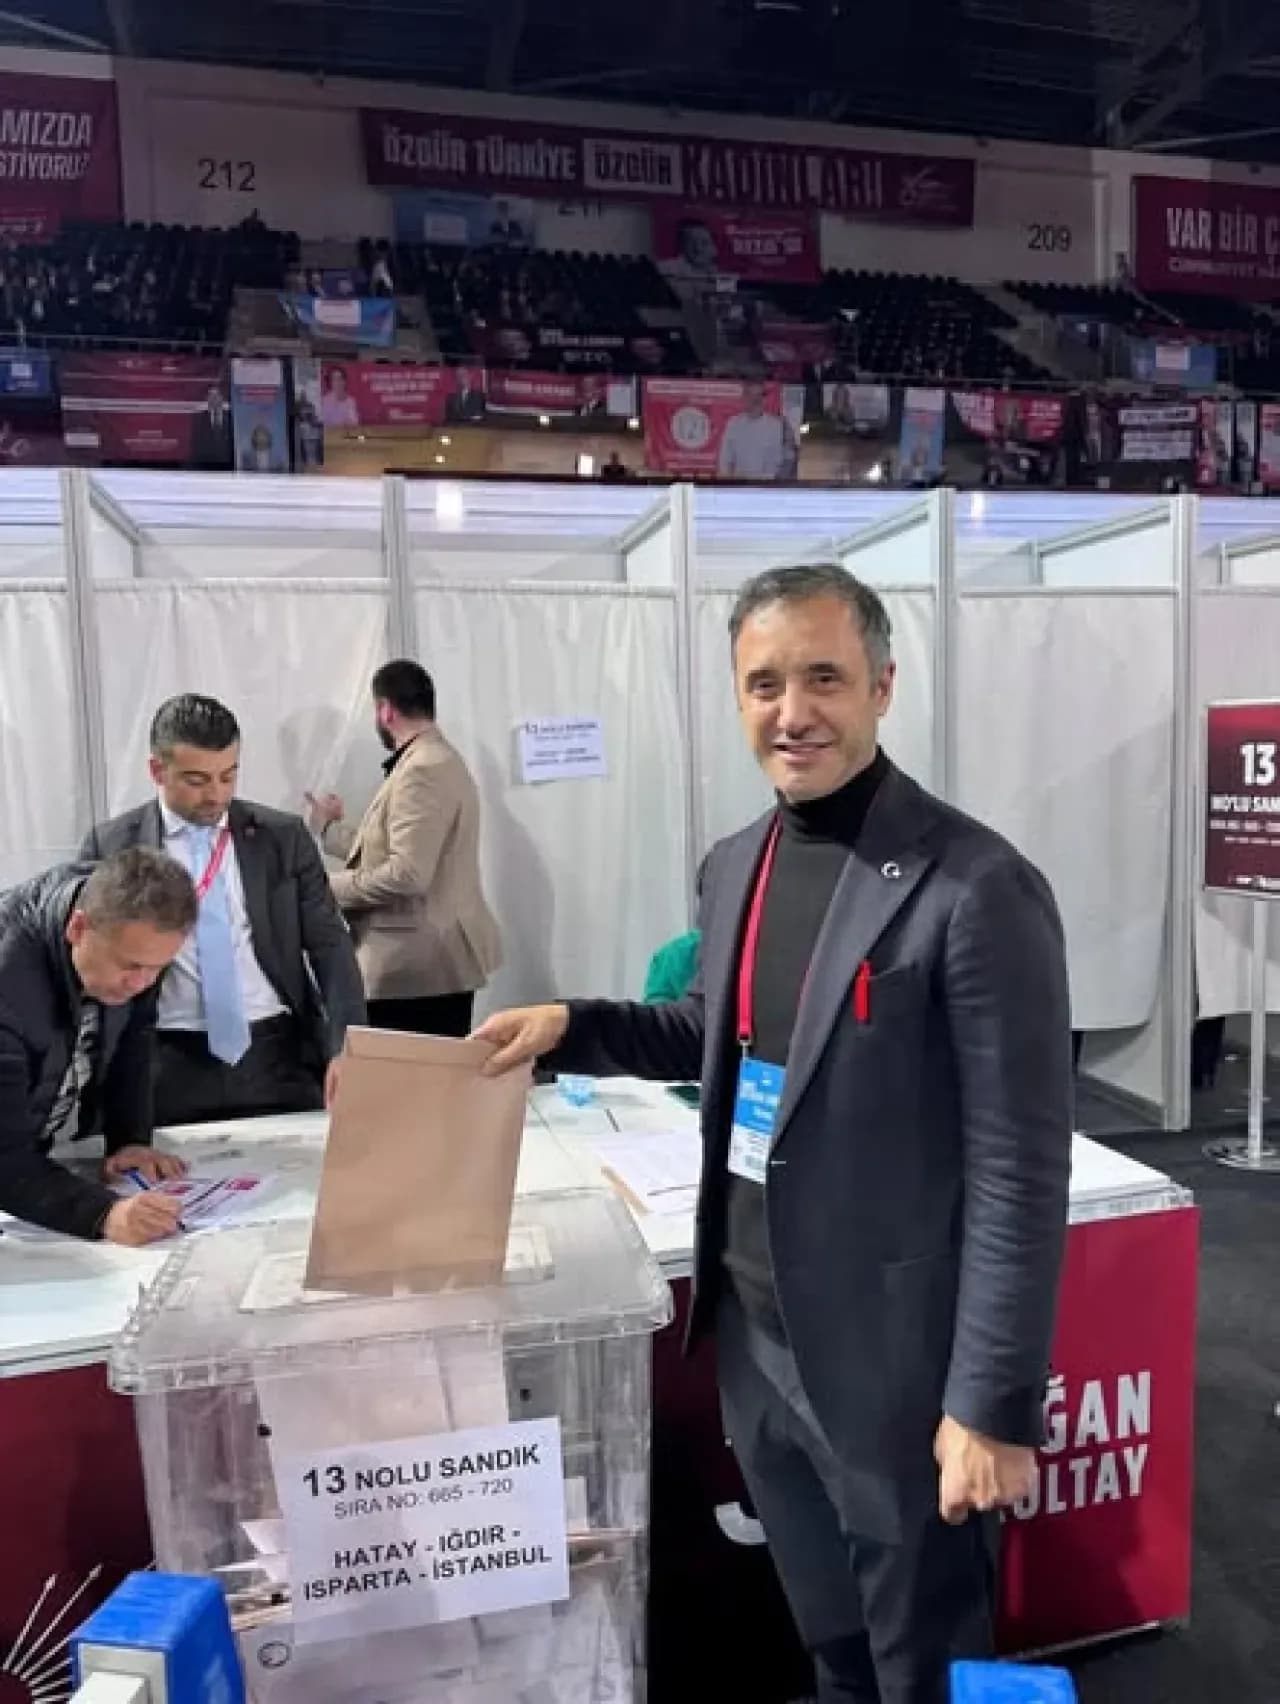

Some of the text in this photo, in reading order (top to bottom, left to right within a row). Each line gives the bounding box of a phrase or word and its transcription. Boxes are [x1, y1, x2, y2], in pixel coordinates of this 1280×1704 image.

[0, 110, 92, 147] MIZDA
[198, 158, 256, 191] 212
[1028, 224, 1072, 253] 209
[1166, 207, 1212, 249] VAR
[1219, 204, 1258, 255] BİR
[1240, 742, 1277, 786] 13
[303, 1443, 541, 1497] 13 NOLU SANDIK
[334, 1495, 383, 1519] SIRA
[480, 1478, 514, 1497] 720
[334, 1539, 417, 1568] HATAY
[304, 1567, 412, 1601] ISPARTA
